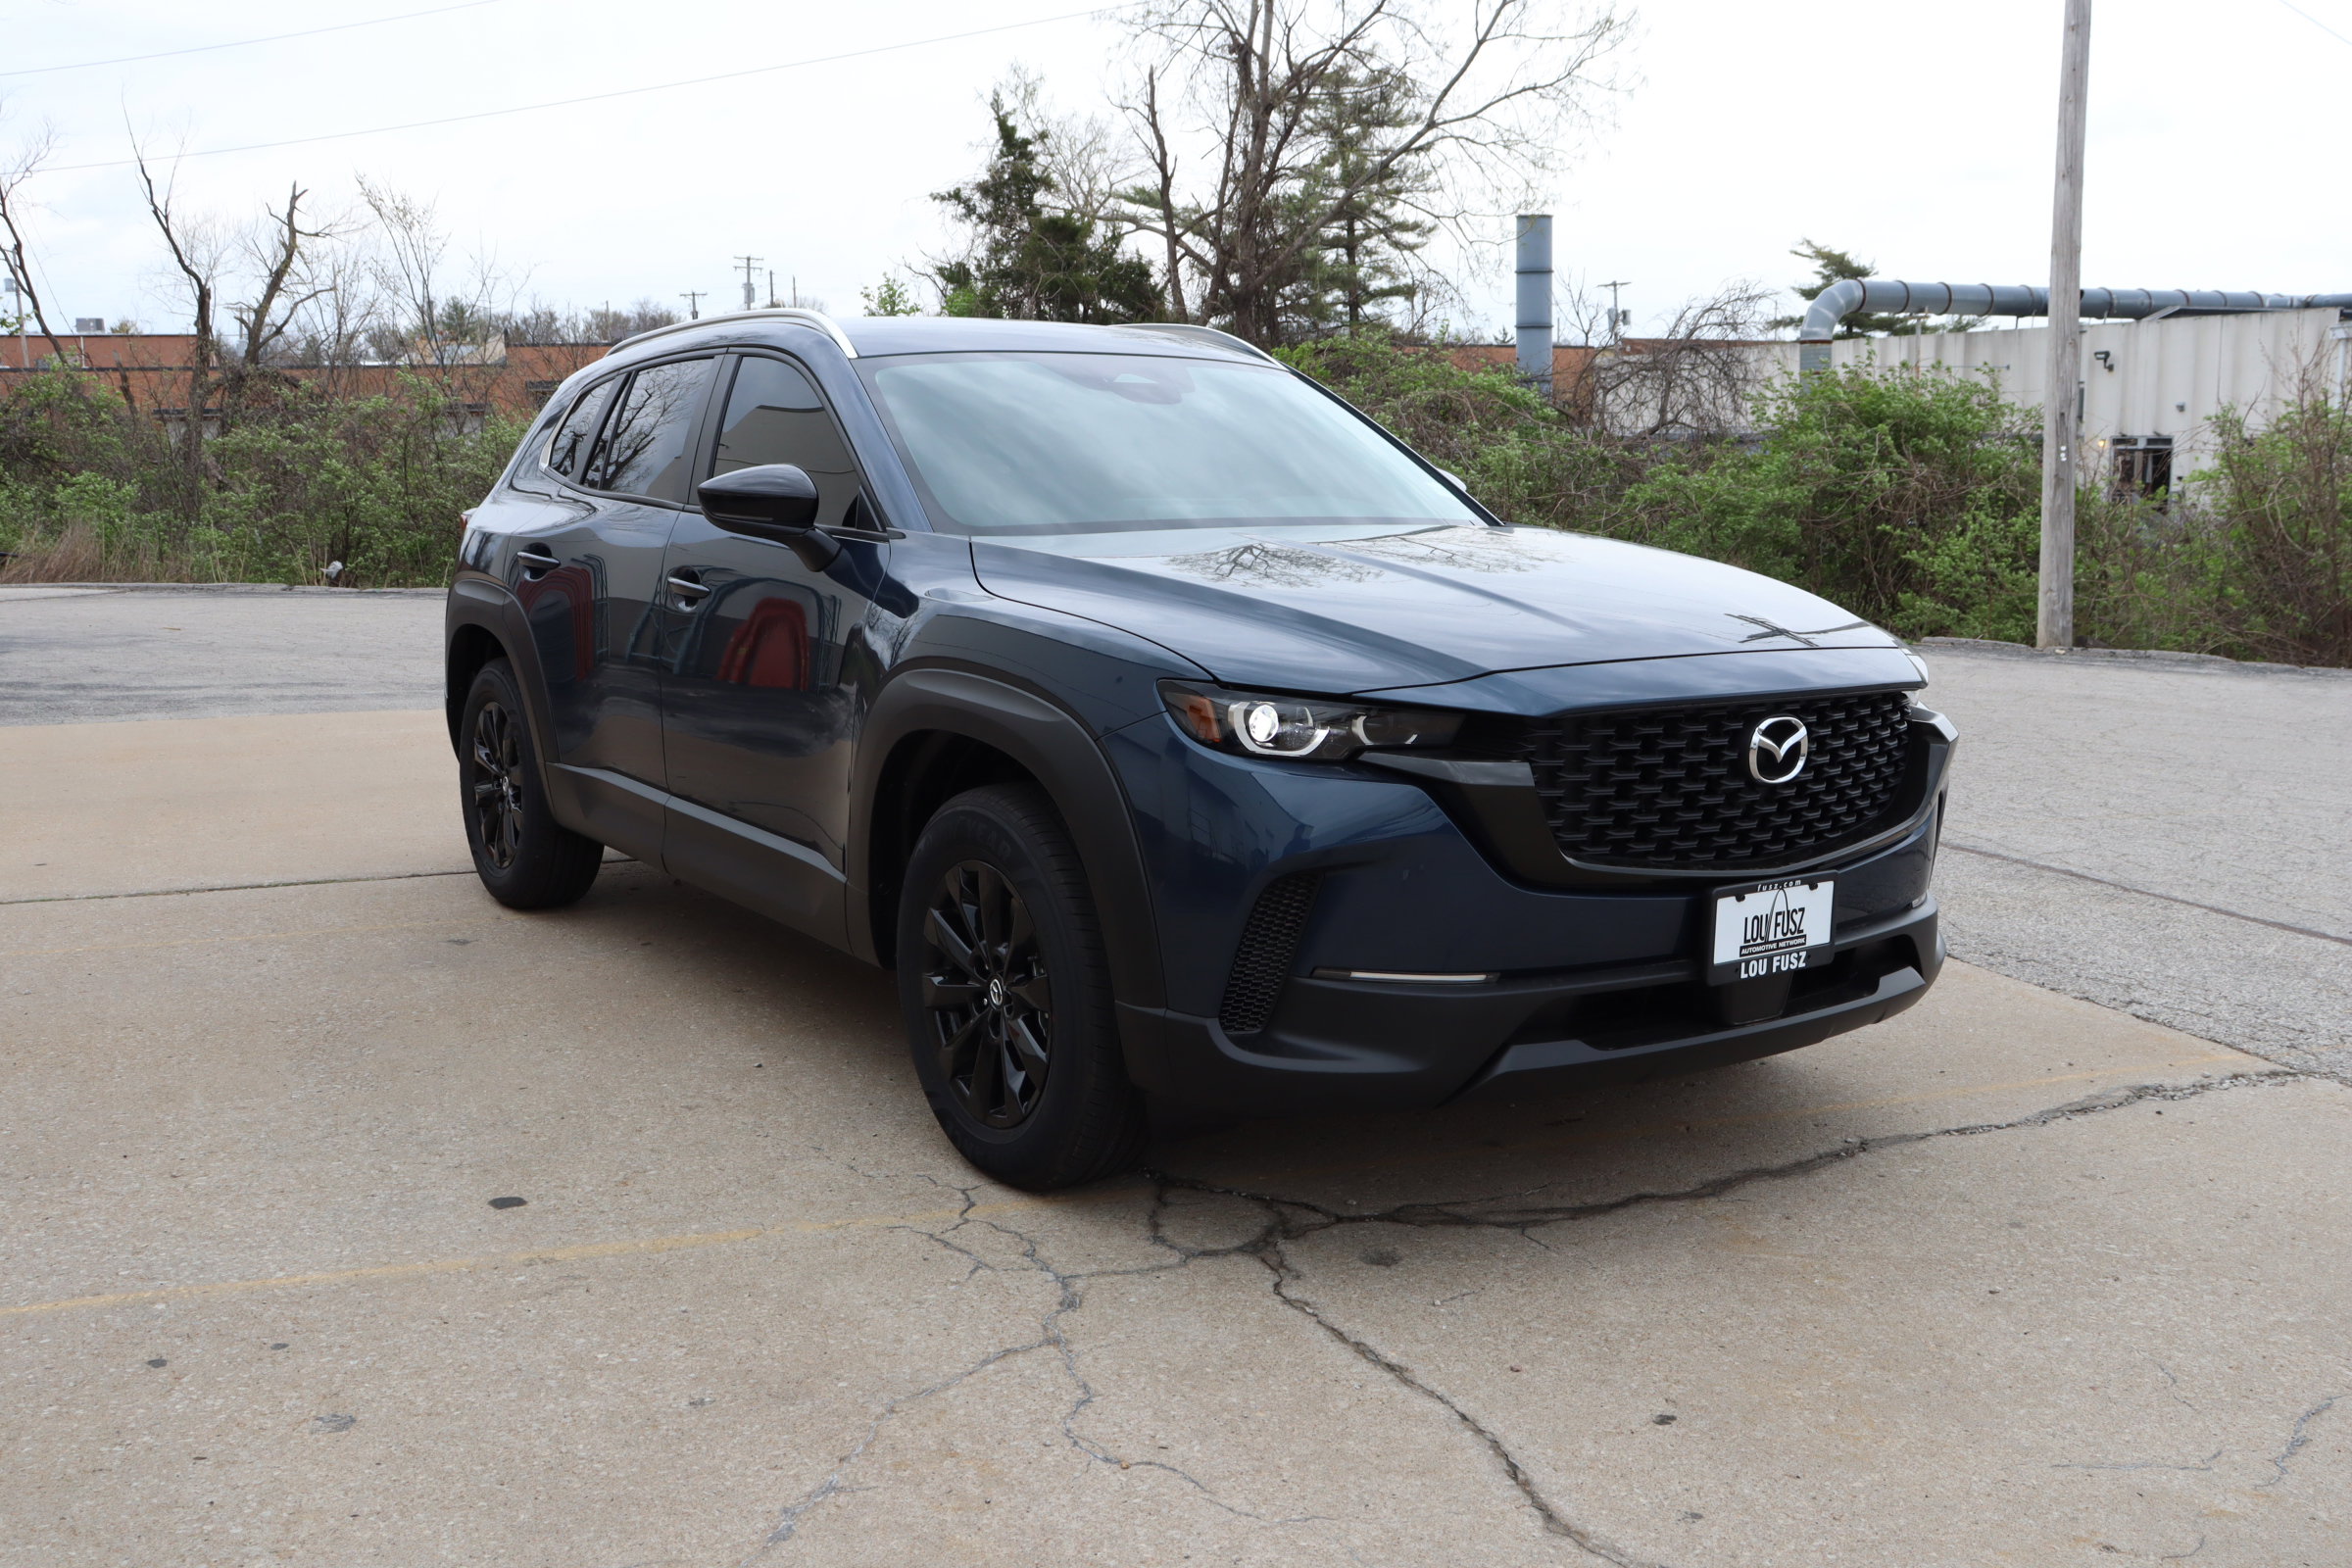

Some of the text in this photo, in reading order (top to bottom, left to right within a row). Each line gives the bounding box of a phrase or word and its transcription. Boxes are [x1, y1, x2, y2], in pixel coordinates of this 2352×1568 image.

[1757, 879, 1801, 892] fusz.com
[1743, 907, 1805, 944] LOU FUSZ
[1740, 937, 1805, 955] AUTOMOTIVE NETWORK
[1740, 952, 1806, 979] LOU FUSZ
